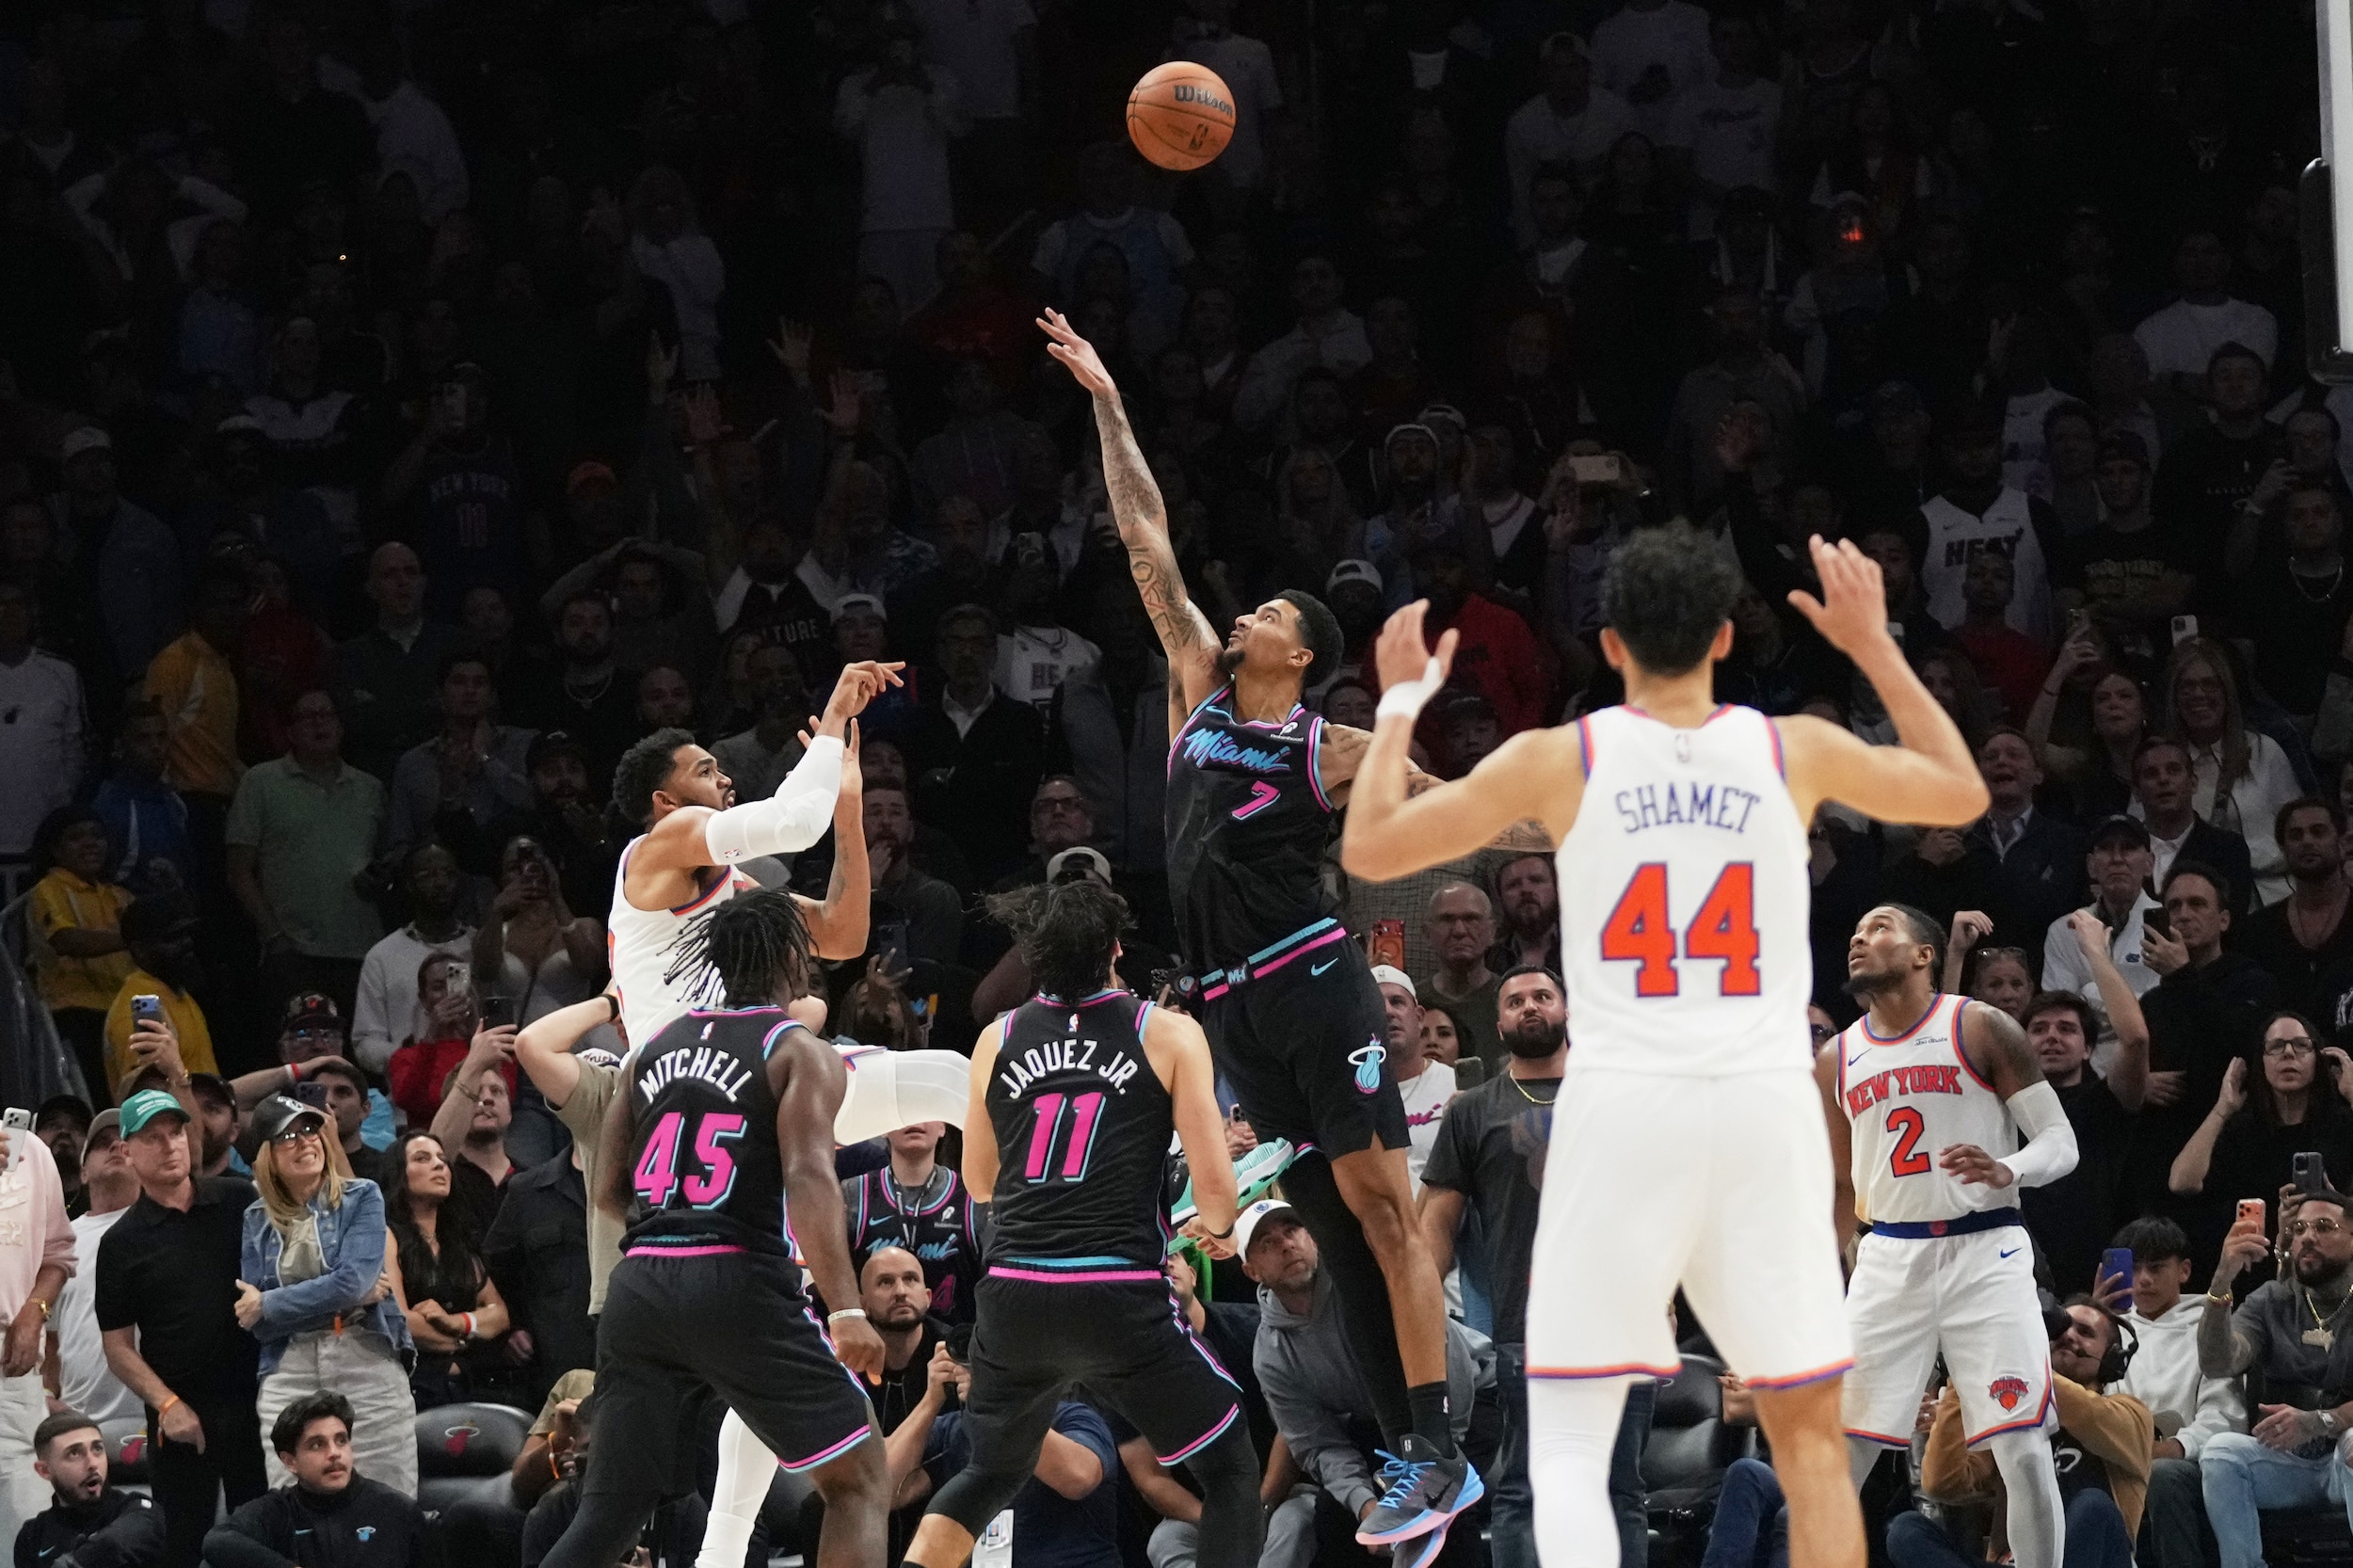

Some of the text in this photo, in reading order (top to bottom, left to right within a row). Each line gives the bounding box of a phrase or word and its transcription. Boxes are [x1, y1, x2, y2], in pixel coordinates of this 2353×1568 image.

[1174, 85, 1233, 118] Wilson
[772, 617, 820, 644] TURE
[1031, 663, 1061, 690] HE
[1183, 728, 1291, 772] Miami
[1231, 780, 1281, 820] 7
[1614, 781, 1761, 834] SHAMET
[1599, 860, 1762, 999] 44
[638, 1046, 754, 1104] MITCHELL
[1000, 1038, 1139, 1100] JAQUEZ JR.
[1846, 1064, 1963, 1121] NEW YORK
[632, 1111, 748, 1210] 45
[1024, 1092, 1107, 1184] 11
[1885, 1106, 1931, 1177] 2
